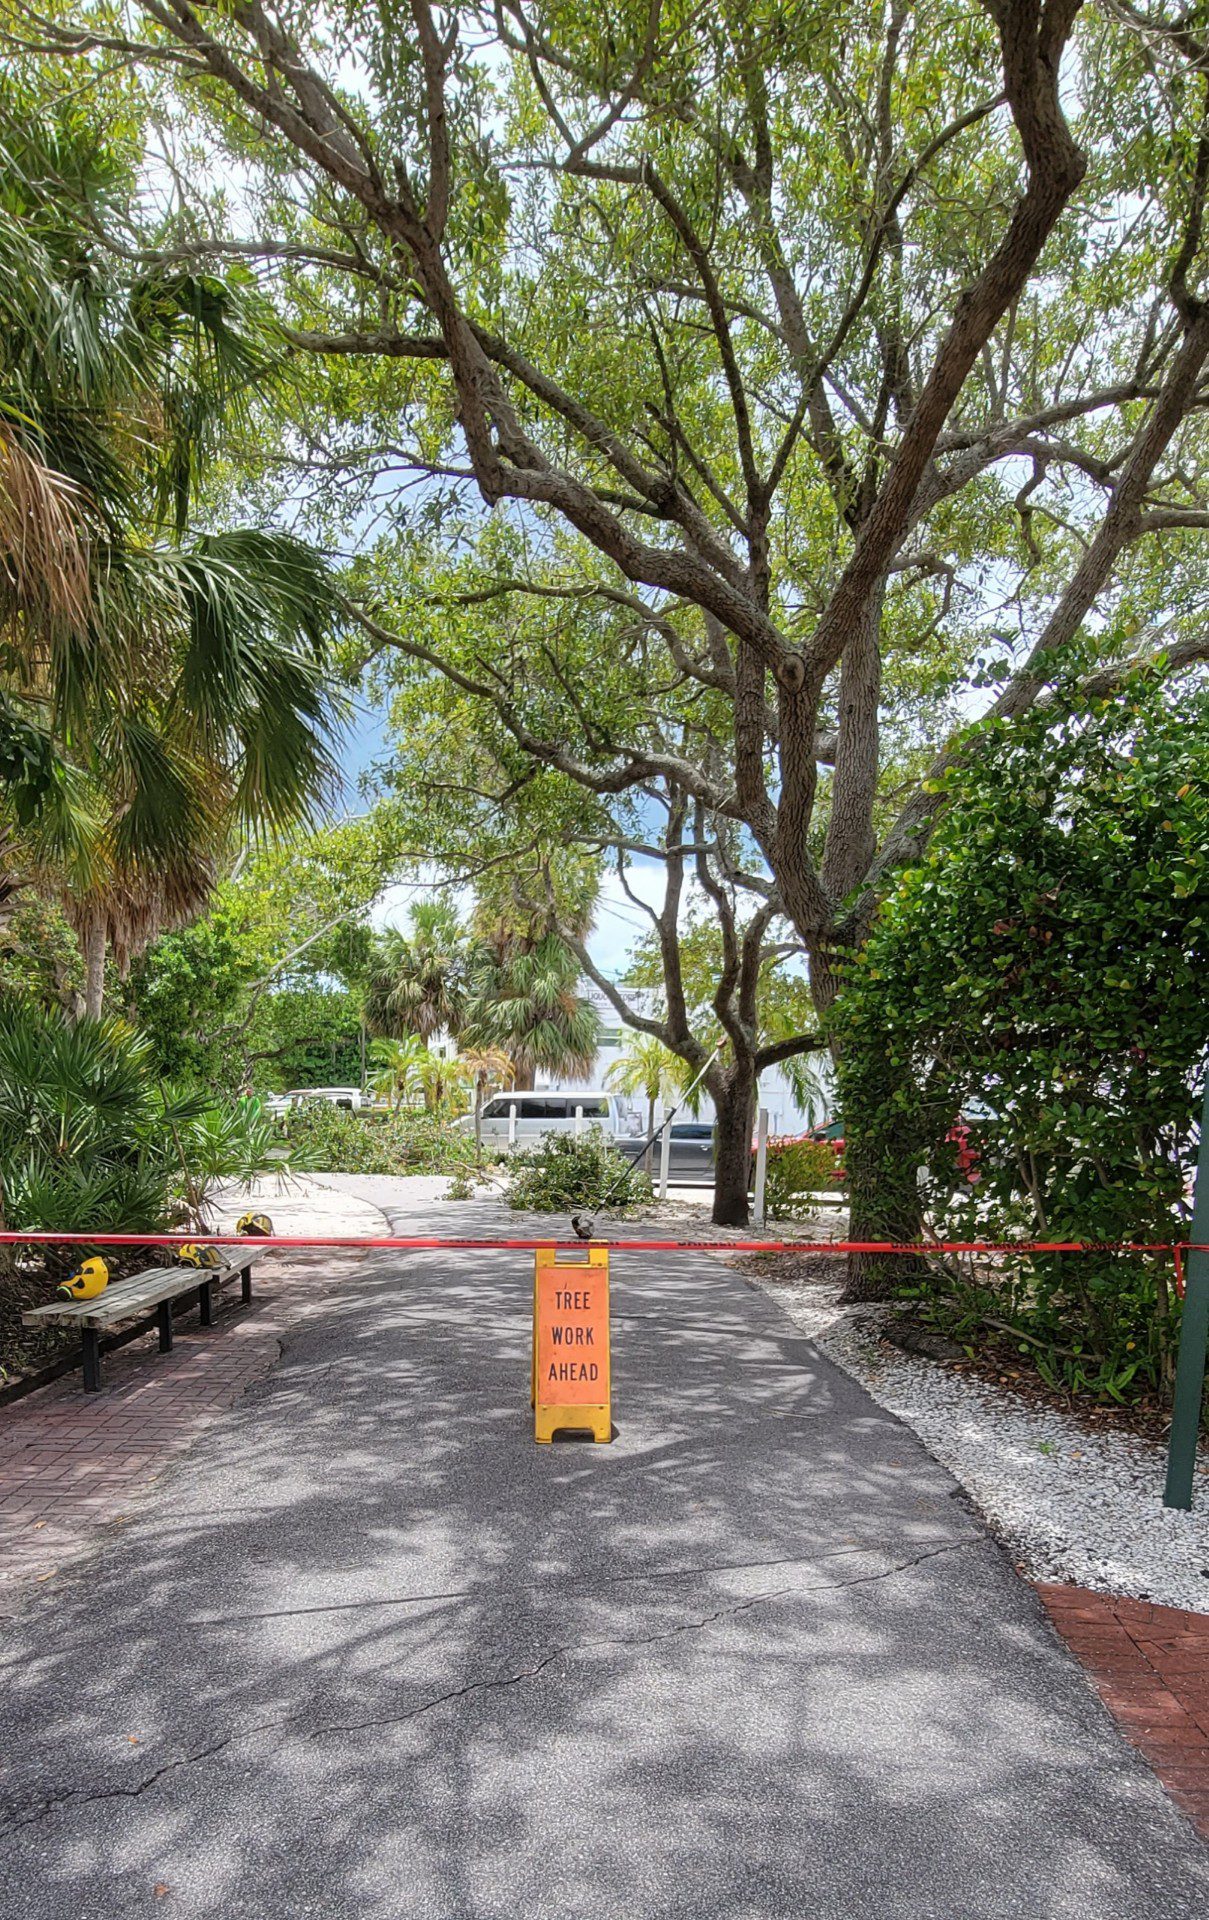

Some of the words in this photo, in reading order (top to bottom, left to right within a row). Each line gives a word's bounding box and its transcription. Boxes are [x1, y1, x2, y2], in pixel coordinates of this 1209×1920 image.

[555, 1291, 591, 1310] TREE
[551, 1327, 595, 1346] WORK
[548, 1363, 599, 1381] AHEAD
